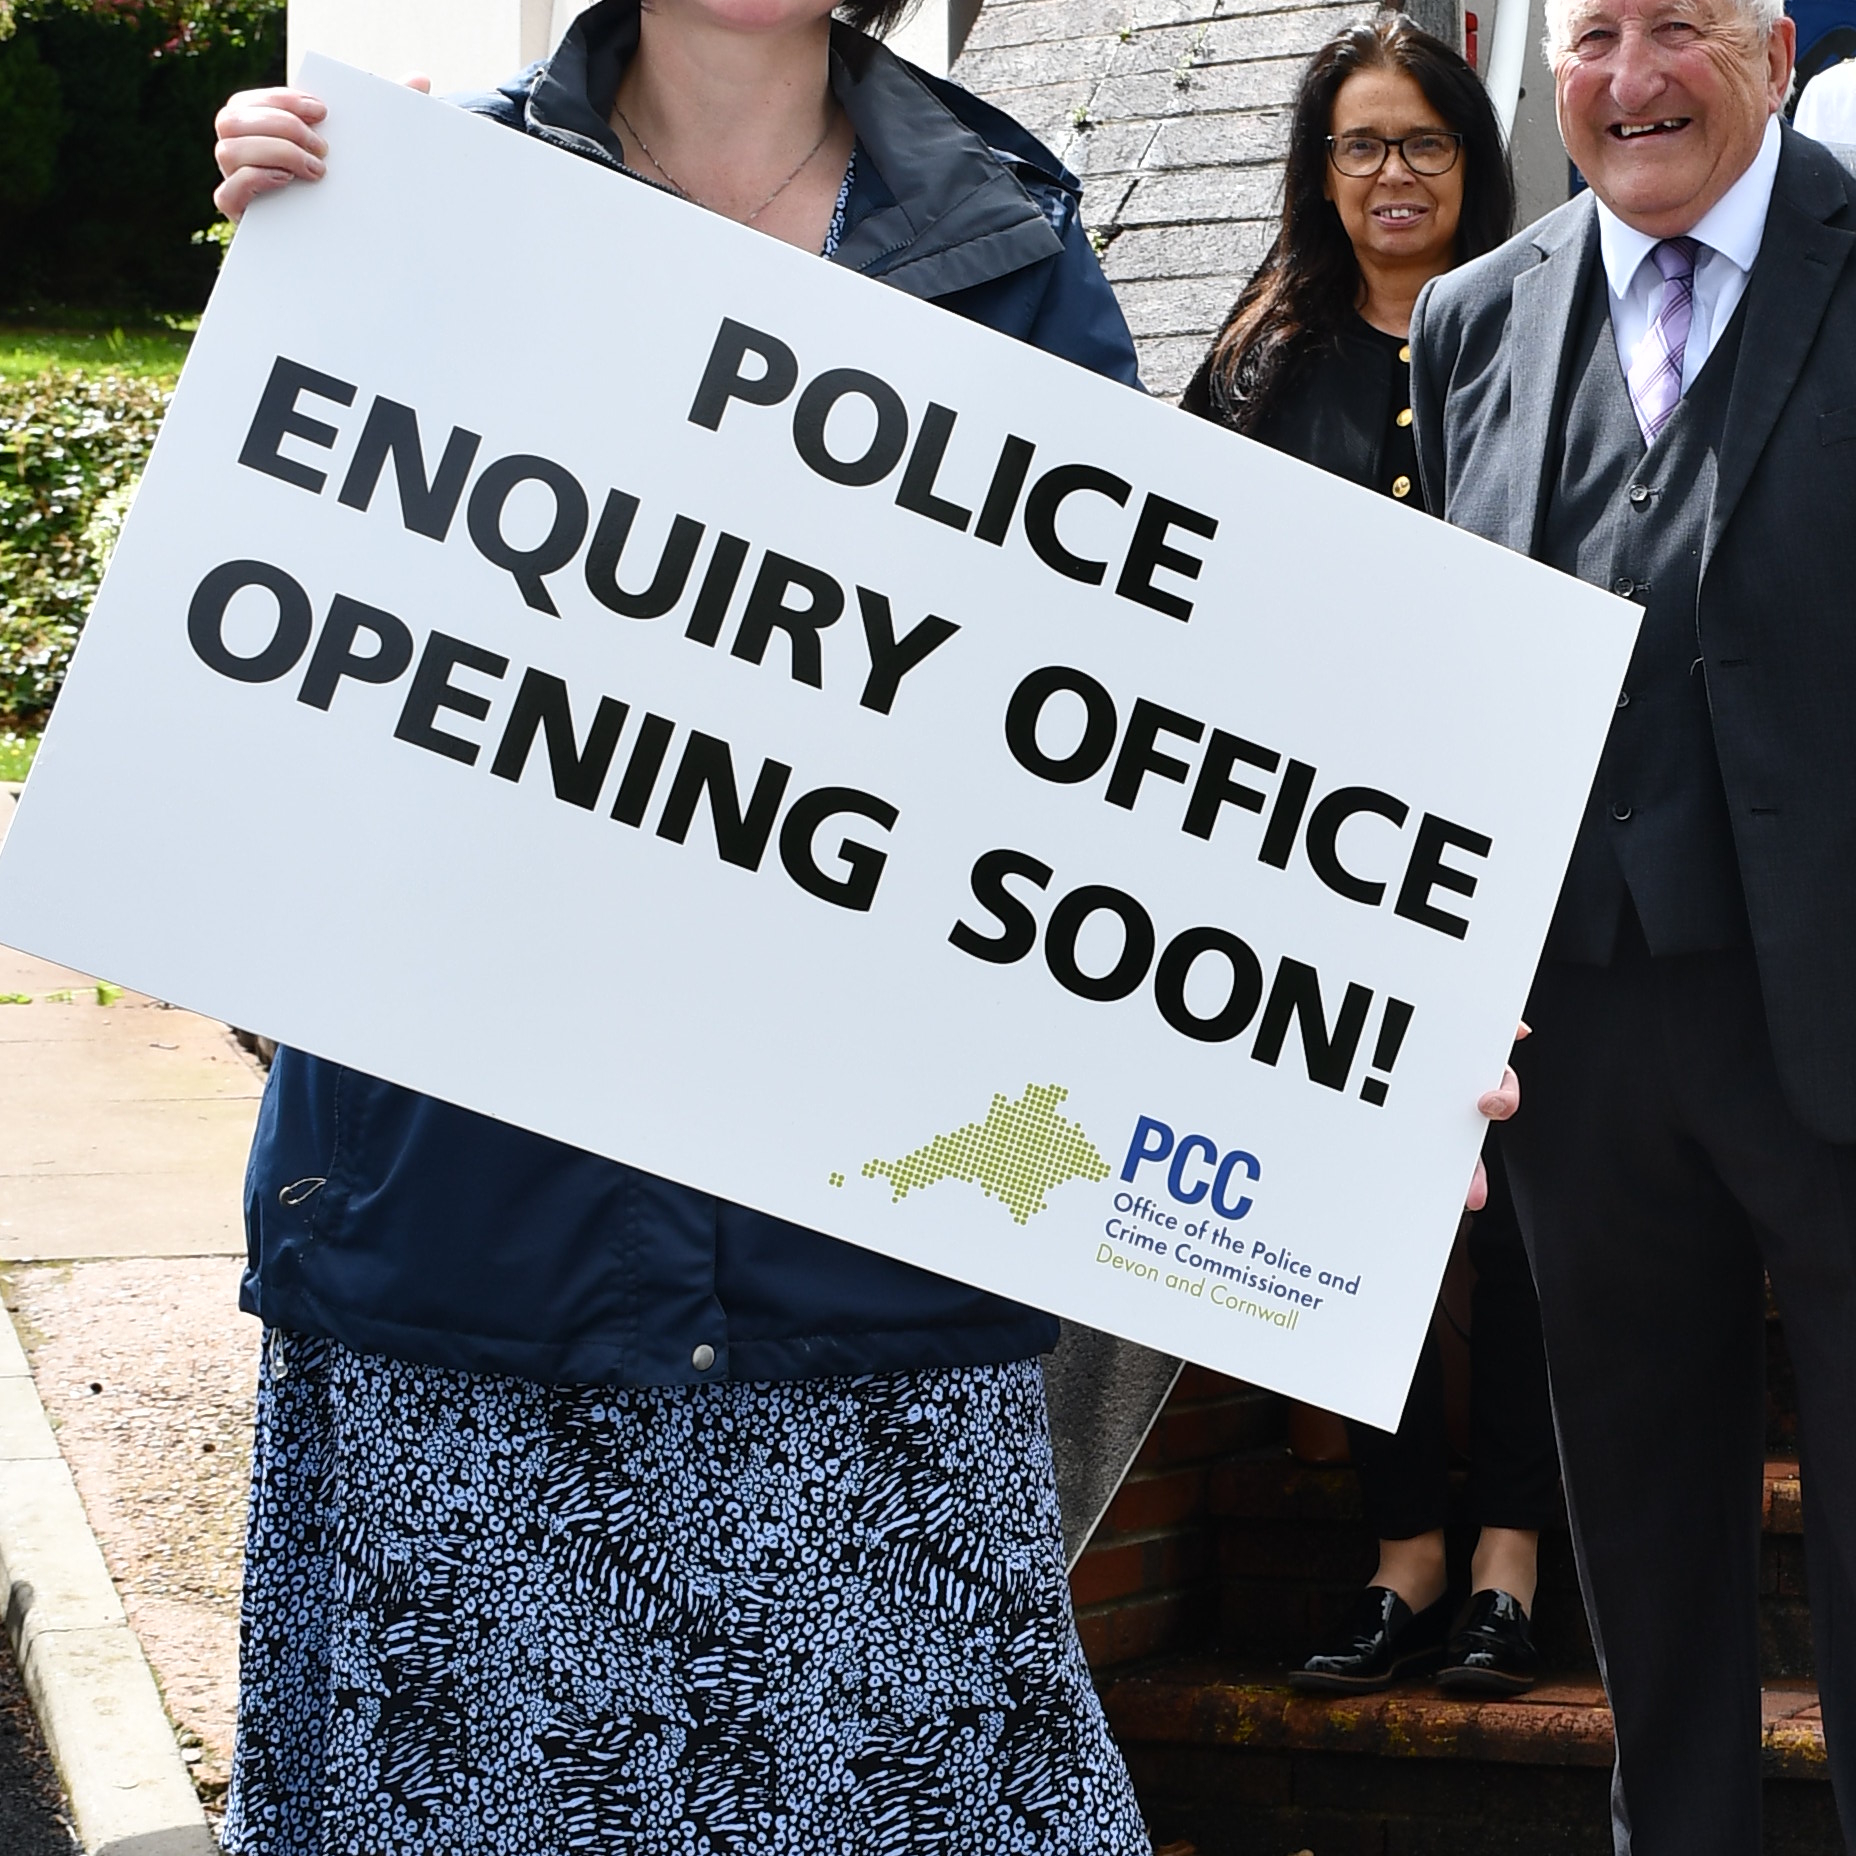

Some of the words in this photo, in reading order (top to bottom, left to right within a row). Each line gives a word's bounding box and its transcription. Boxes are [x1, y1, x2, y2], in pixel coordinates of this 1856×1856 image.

[688, 316, 1219, 623] POLICE
[237, 355, 962, 716] ENQUIRY
[1004, 665, 1493, 941] OFFICE
[187, 559, 900, 912] OPENING
[947, 848, 1414, 1108] SOON!
[1119, 1115, 1262, 1221] PCC
[1096, 1243, 1159, 1282] Devon
[1165, 1274, 1206, 1298] and
[1210, 1285, 1300, 1331] Cornwall
[1105, 1218, 1168, 1255] Crime
[1174, 1243, 1324, 1310] Commissioner
[1113, 1192, 1178, 1230] Office
[1184, 1220, 1210, 1240] of
[1211, 1227, 1245, 1255] the
[1250, 1241, 1313, 1278] Police
[1318, 1271, 1362, 1295] and
